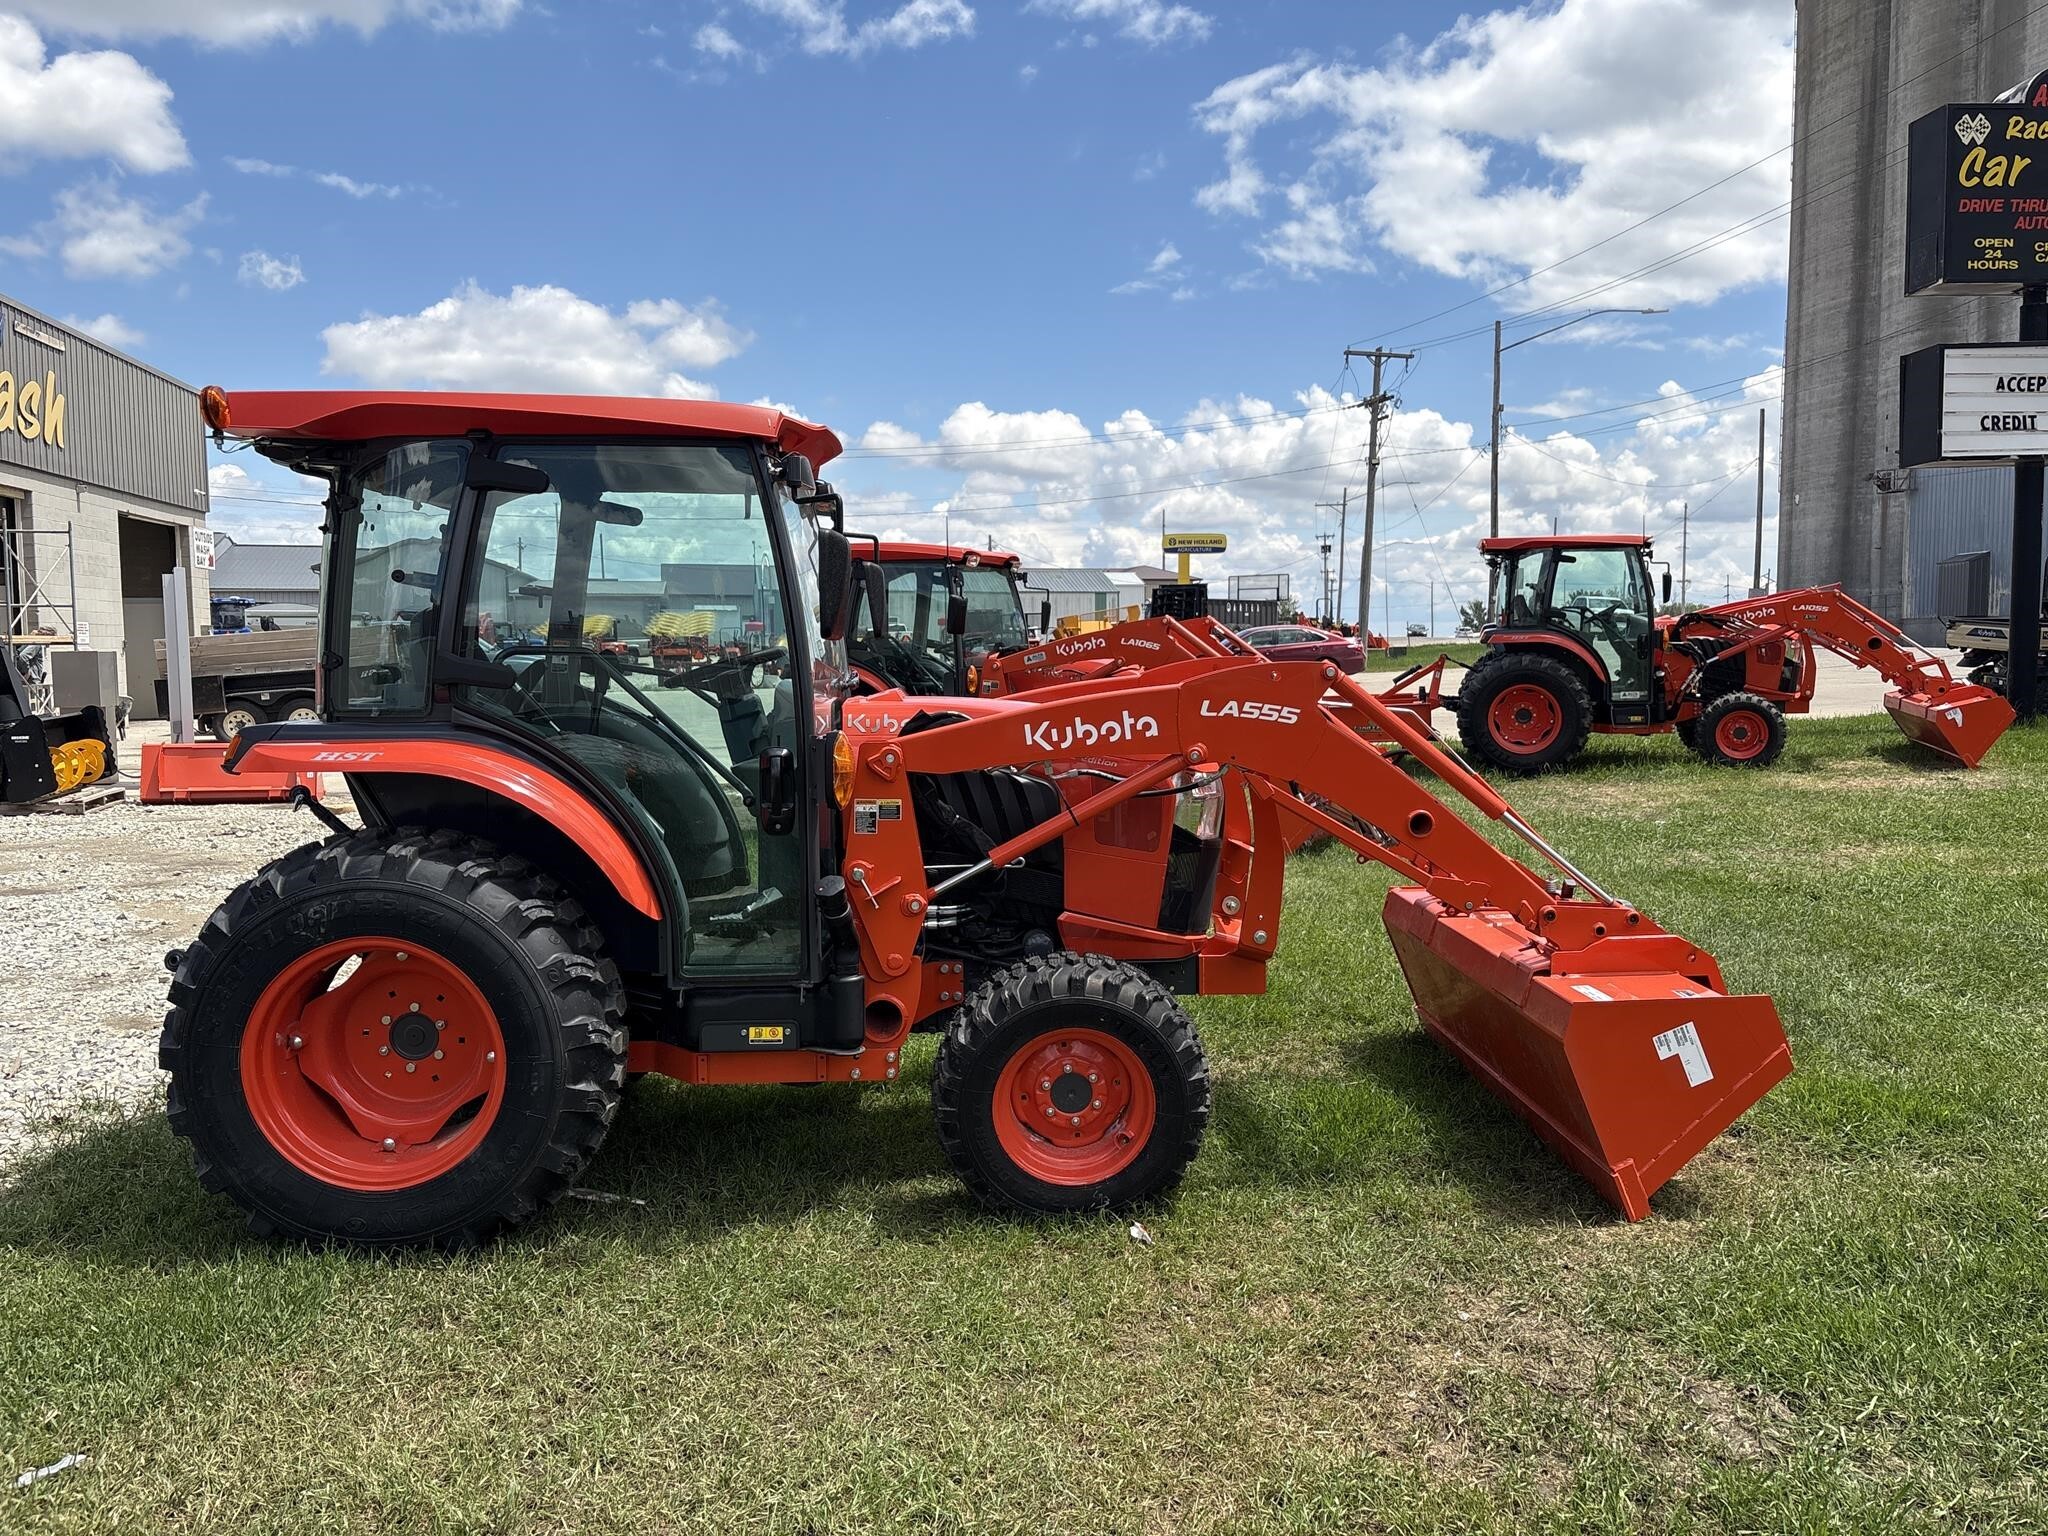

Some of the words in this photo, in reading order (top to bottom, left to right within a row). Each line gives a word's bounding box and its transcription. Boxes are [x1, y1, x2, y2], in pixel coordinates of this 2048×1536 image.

[1958, 146, 2032, 188] Car
[1958, 199, 2004, 213] DRIVE
[1974, 238, 2014, 248] OPEN
[1984, 249, 2003, 259] 24
[1967, 260, 2019, 270] HOURS
[1996, 376, 2048, 392] ACCEP
[1980, 415, 2038, 432] CREDIT
[1056, 637, 1106, 656] Kubota
[1120, 637, 1161, 651] LA1065
[1199, 700, 1301, 725] LA555
[1024, 710, 1159, 751] Kubota
[310, 752, 384, 761] HST
